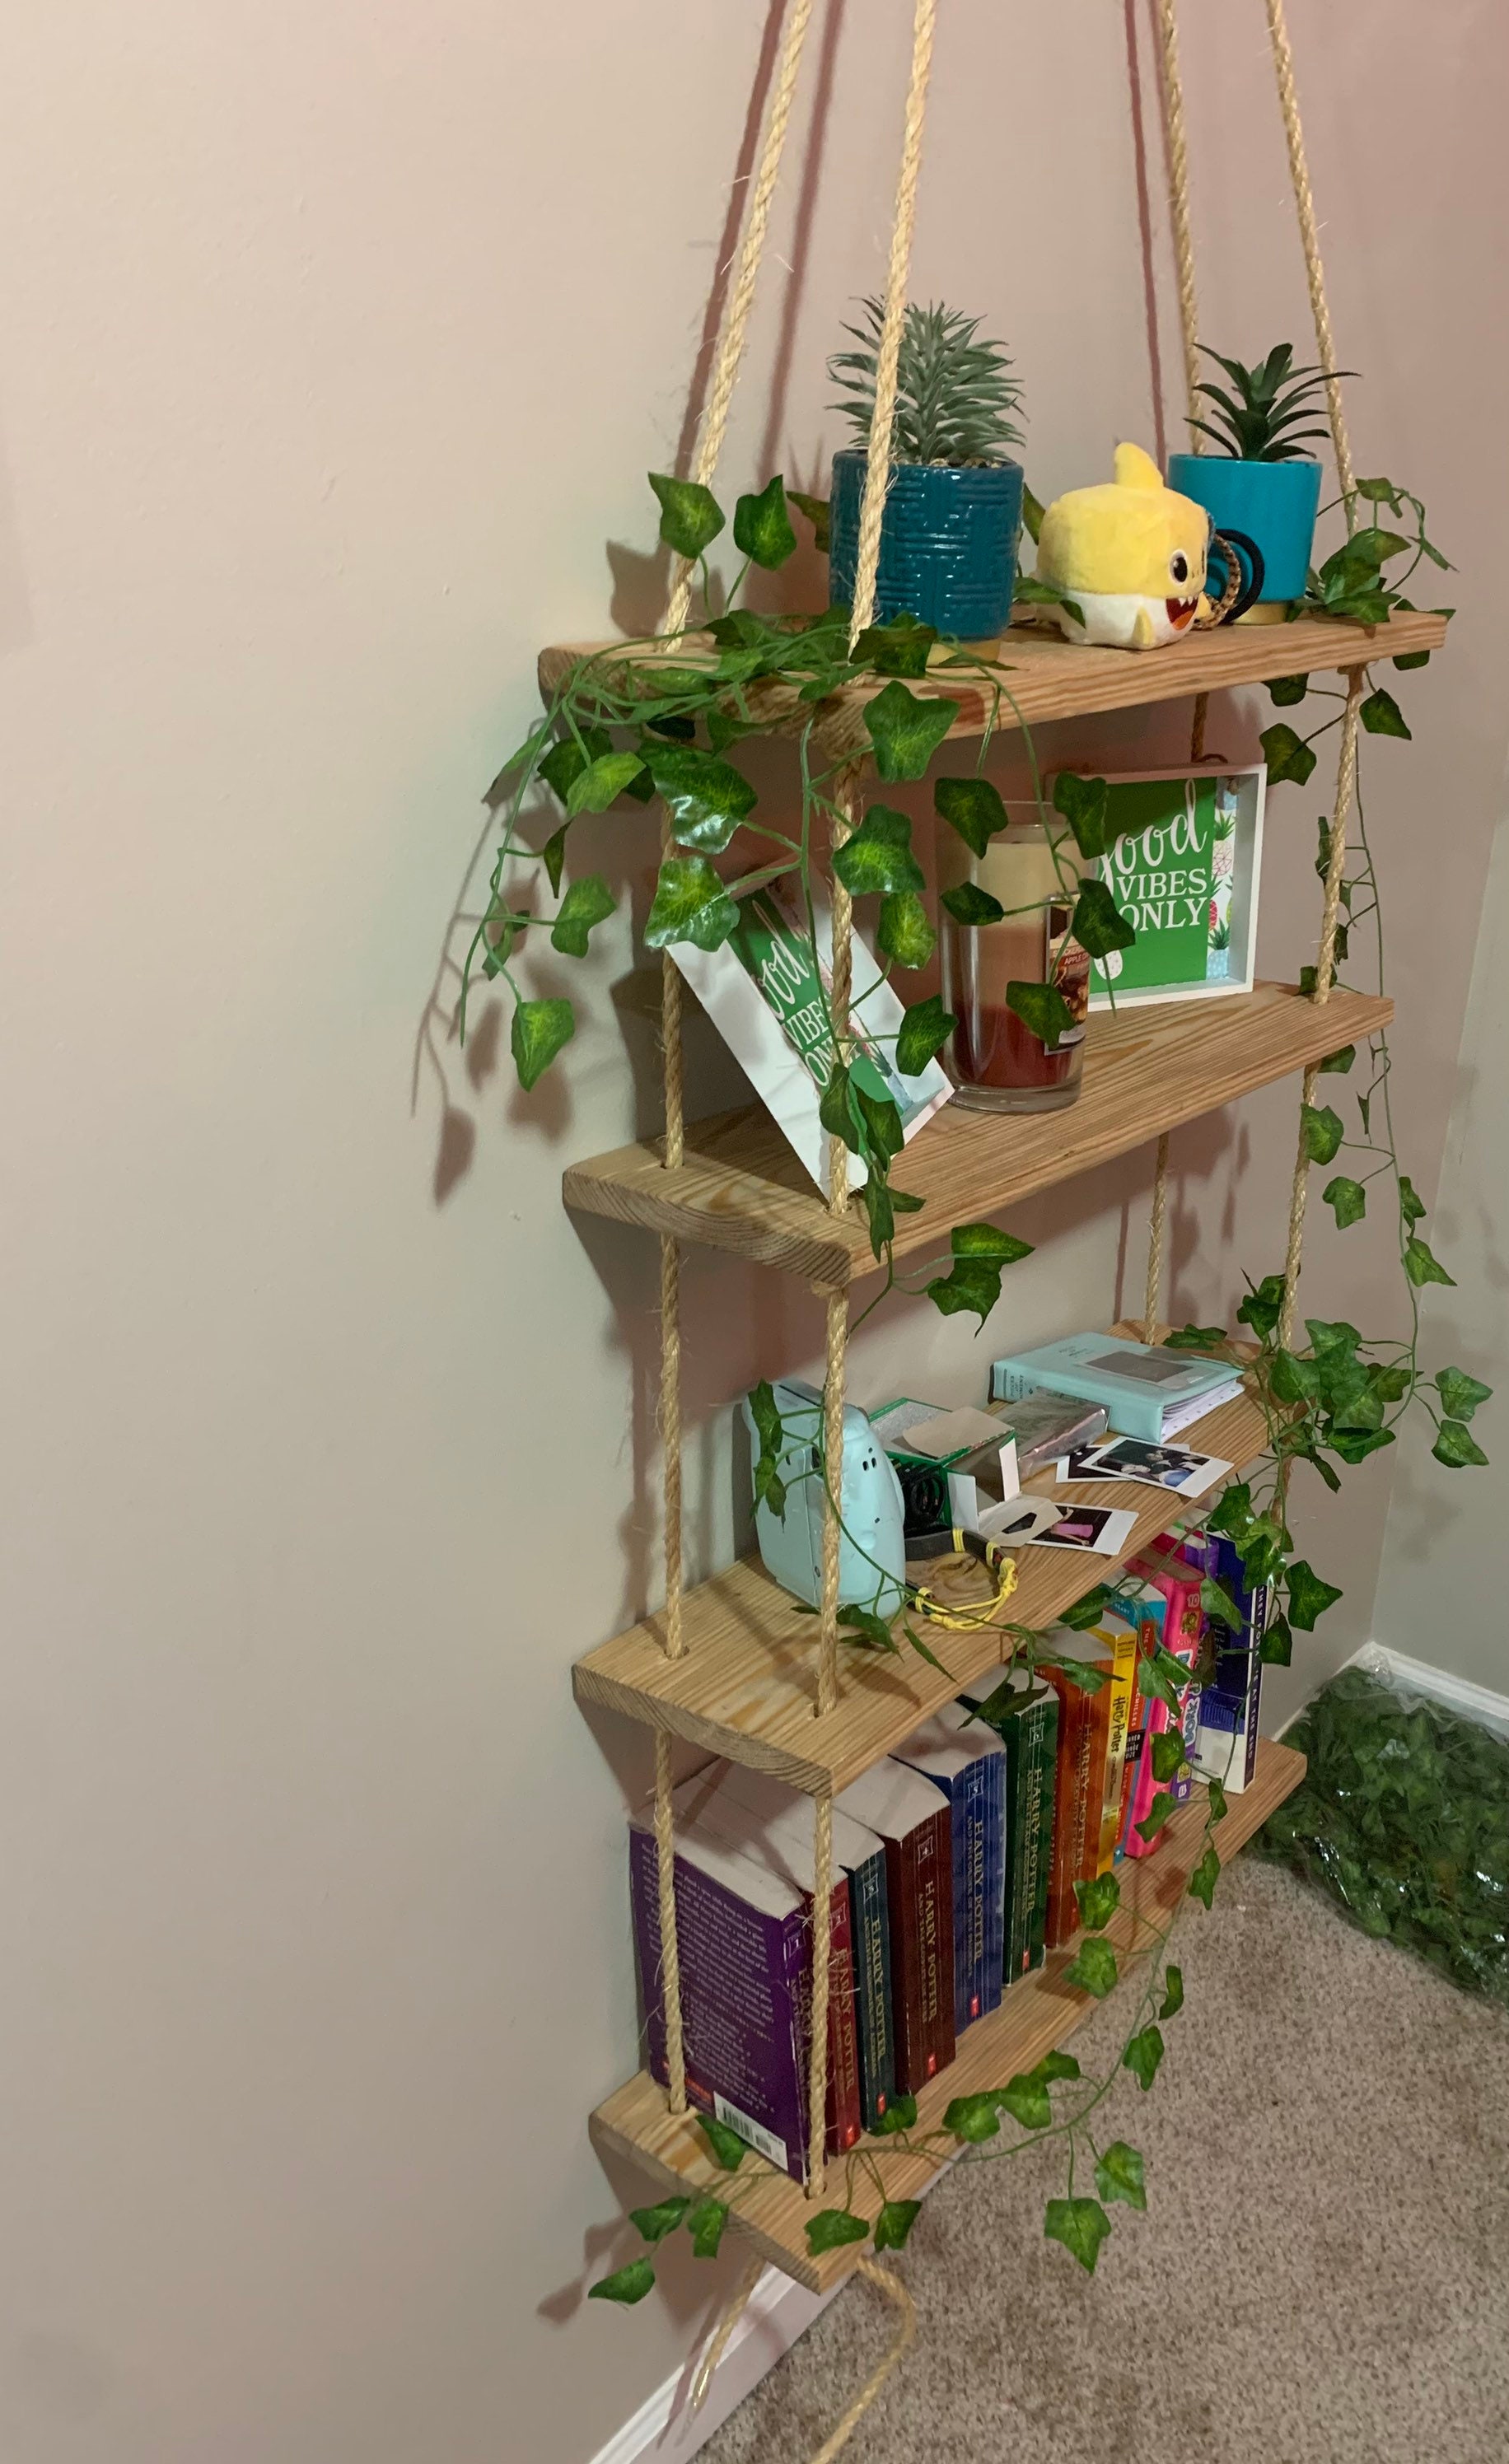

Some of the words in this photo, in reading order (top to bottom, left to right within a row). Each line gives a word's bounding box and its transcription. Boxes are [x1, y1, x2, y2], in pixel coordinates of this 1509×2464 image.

[1115, 868, 1208, 903] VIBES
[1118, 897, 1208, 932] ONLY
[751, 899, 810, 1020] ood
[1187, 1593, 1200, 1607] 10
[1257, 1586, 1265, 1617] THEY
[1111, 1723, 1124, 1752] Potter
[1112, 1695, 1126, 1724] Harry
[1184, 1699, 1199, 1746] DORK
[1083, 1723, 1093, 1790] HARRY
[972, 1785, 979, 1796] 5
[1031, 1767, 1042, 1835] HARRY
[921, 1845, 928, 1856] 4
[974, 1819, 983, 1887] HARRY
[1076, 1798, 1087, 1867] POTTER
[1027, 1844, 1038, 1911] POTTER
[793, 1937, 800, 1949] 1
[925, 1879, 936, 1945] HARRY
[974, 1894, 983, 1960] POTTER
[871, 1917, 884, 1988] HARRY
[927, 1953, 937, 2019] POTTER
[843, 2020, 855, 2092] POTTER
[875, 1992, 885, 2059] POTTER
